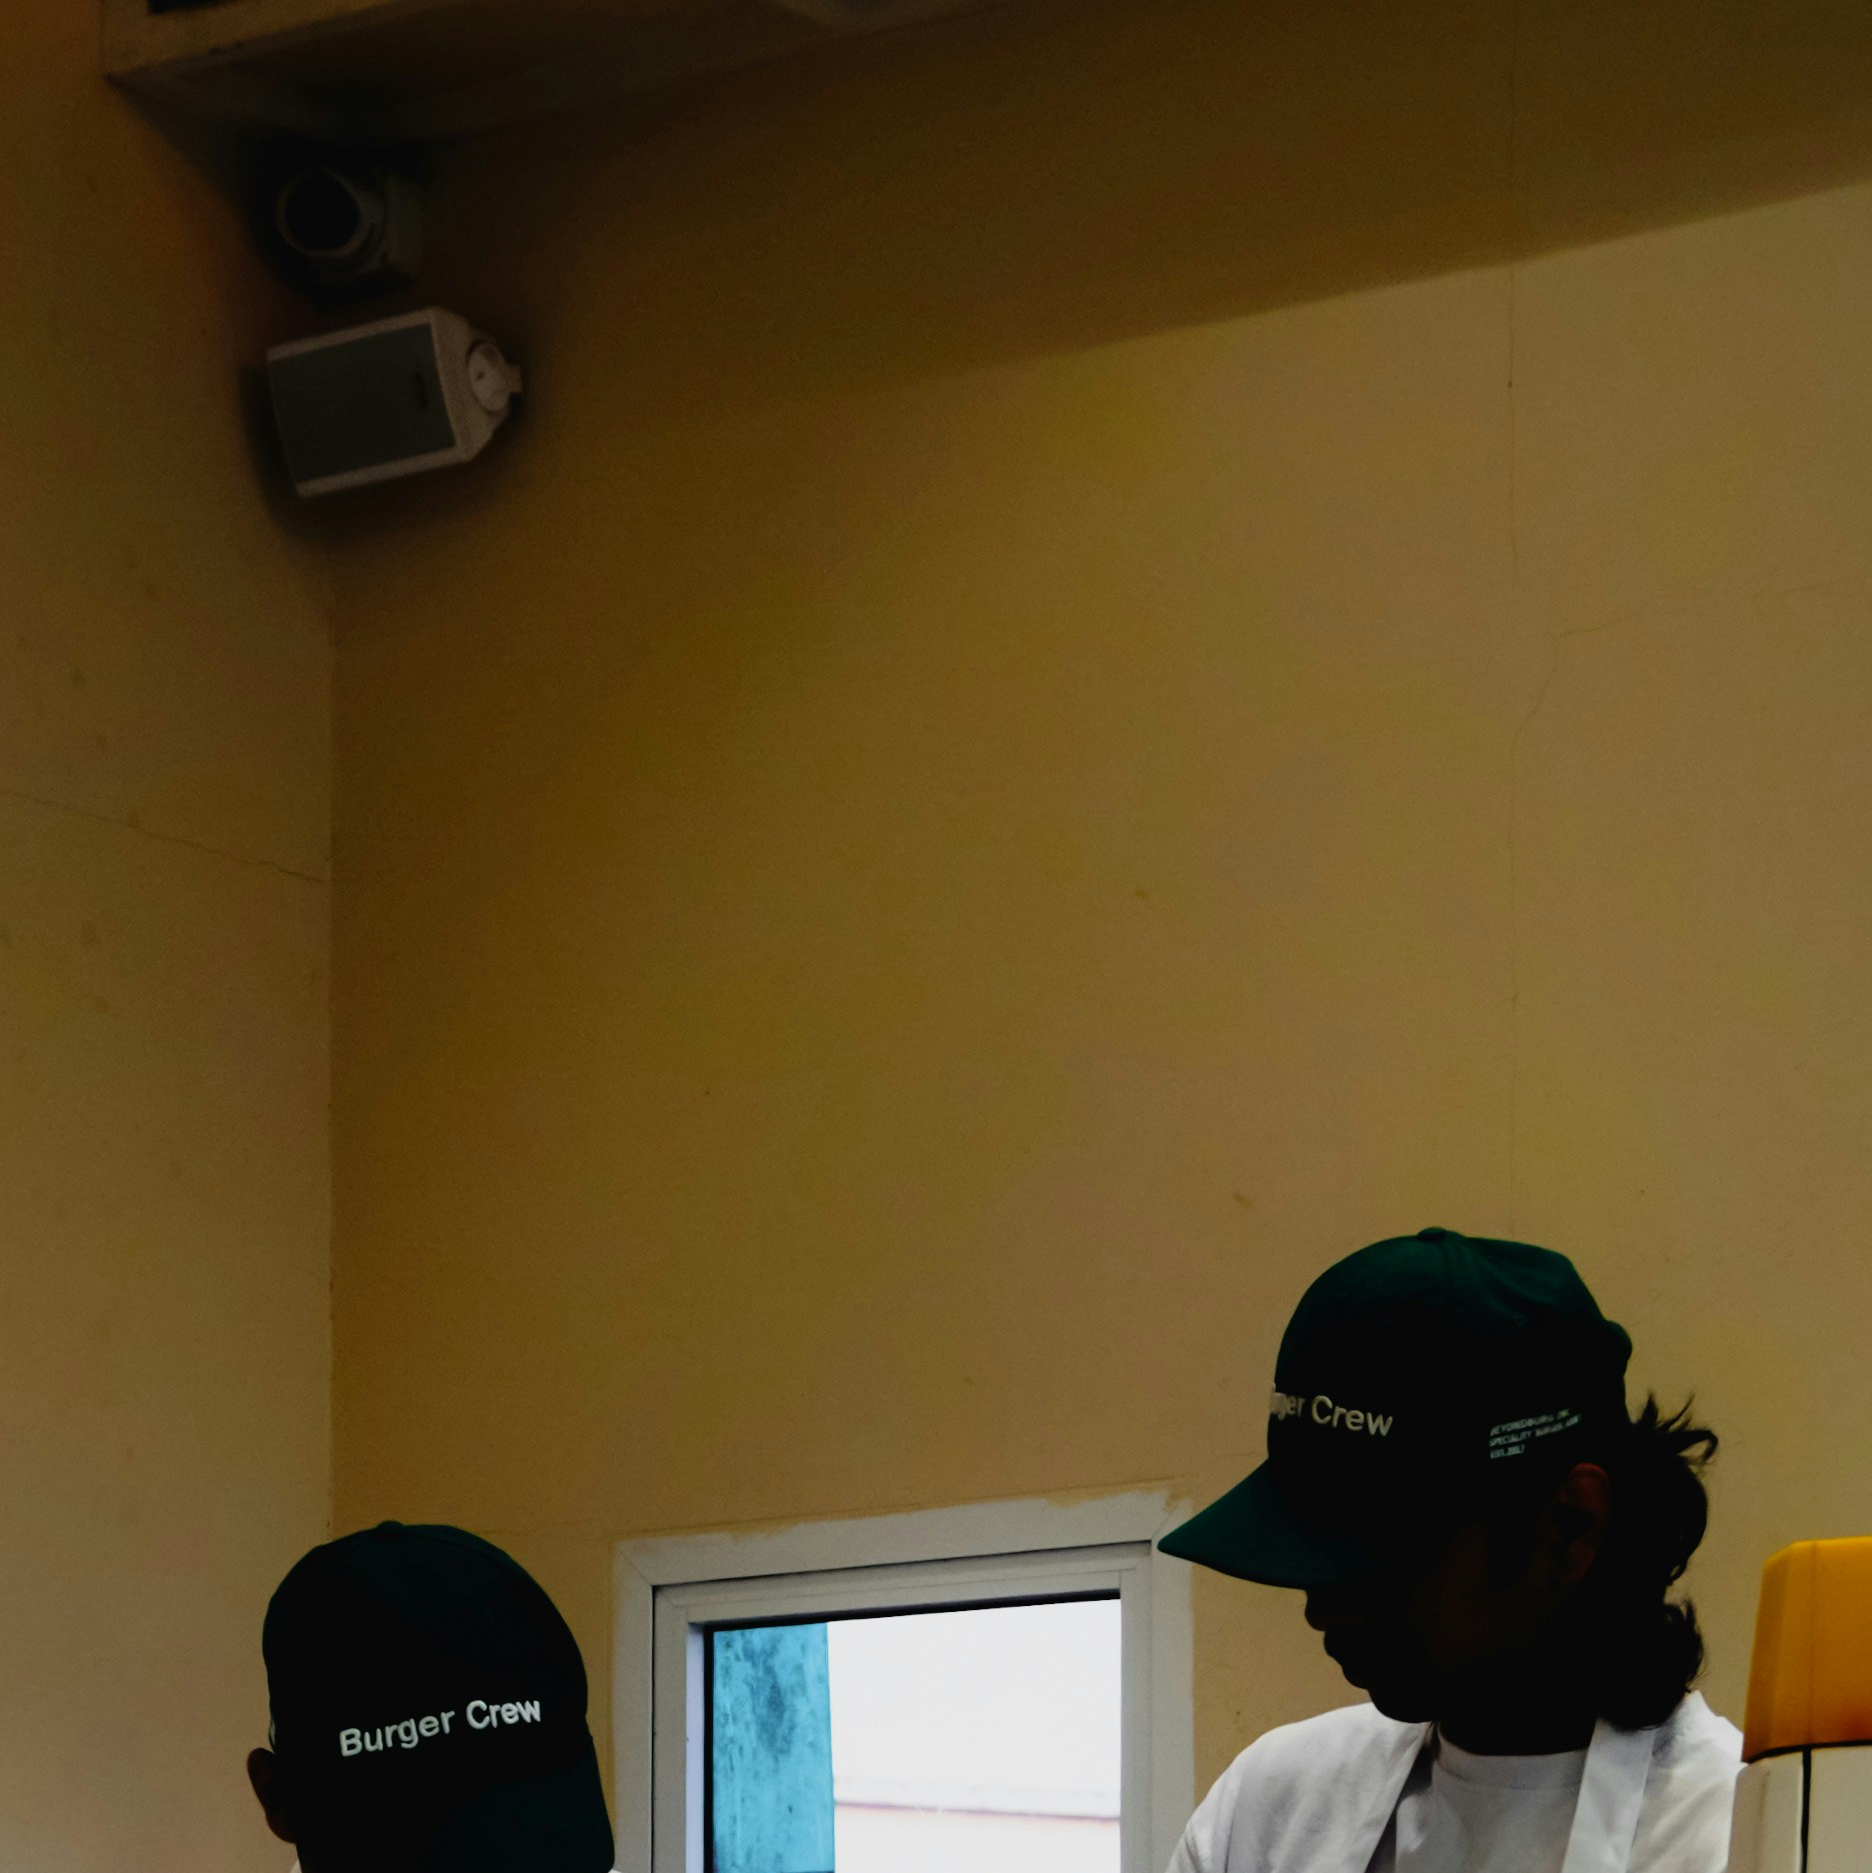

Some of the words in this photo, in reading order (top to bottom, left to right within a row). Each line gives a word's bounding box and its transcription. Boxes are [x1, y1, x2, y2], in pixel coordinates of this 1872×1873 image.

[1311, 1394, 1394, 1437] Crew
[339, 1711, 455, 1758] Burger
[465, 1698, 542, 1730] Crew
